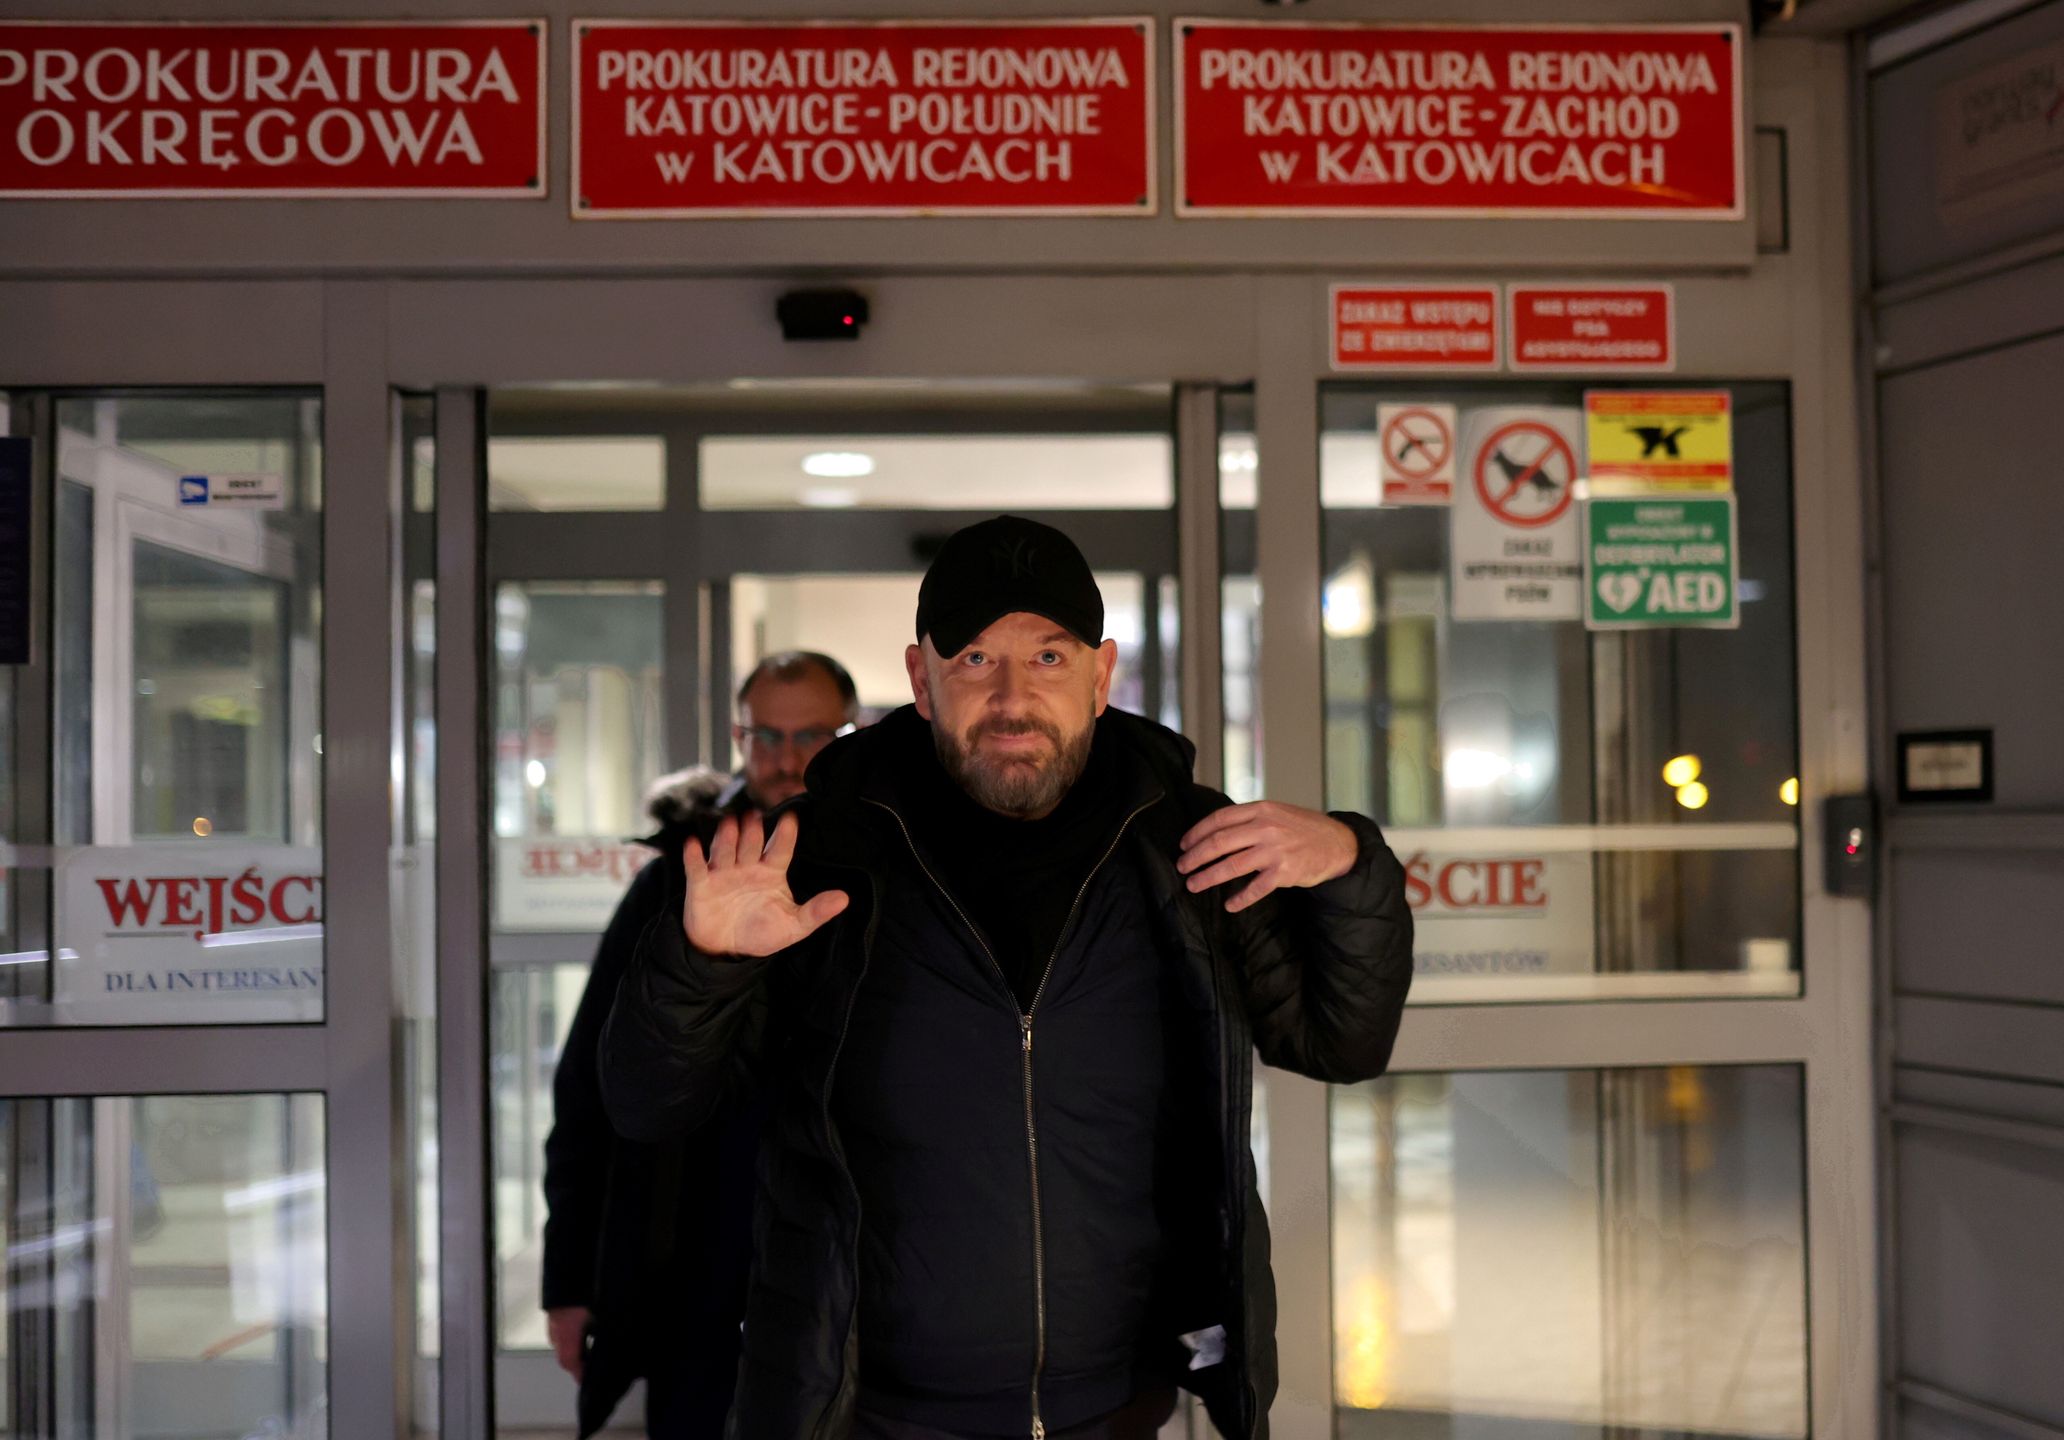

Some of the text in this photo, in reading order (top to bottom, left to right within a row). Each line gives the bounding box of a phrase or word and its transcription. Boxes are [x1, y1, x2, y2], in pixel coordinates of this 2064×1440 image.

[0, 48, 520, 103] PROKURATURA
[599, 48, 1130, 91] PROKURATURA REJONOWA
[1201, 50, 1719, 95] PROKURATURA REJONOWA
[17, 109, 484, 171] OKRĘGOWA
[714, 140, 1073, 184] KATOWICACH
[1317, 141, 1666, 186] KATOWICACH
[1646, 572, 1727, 614] AED
[95, 865, 323, 942] WEJŚC
[105, 972, 158, 993] DLA
